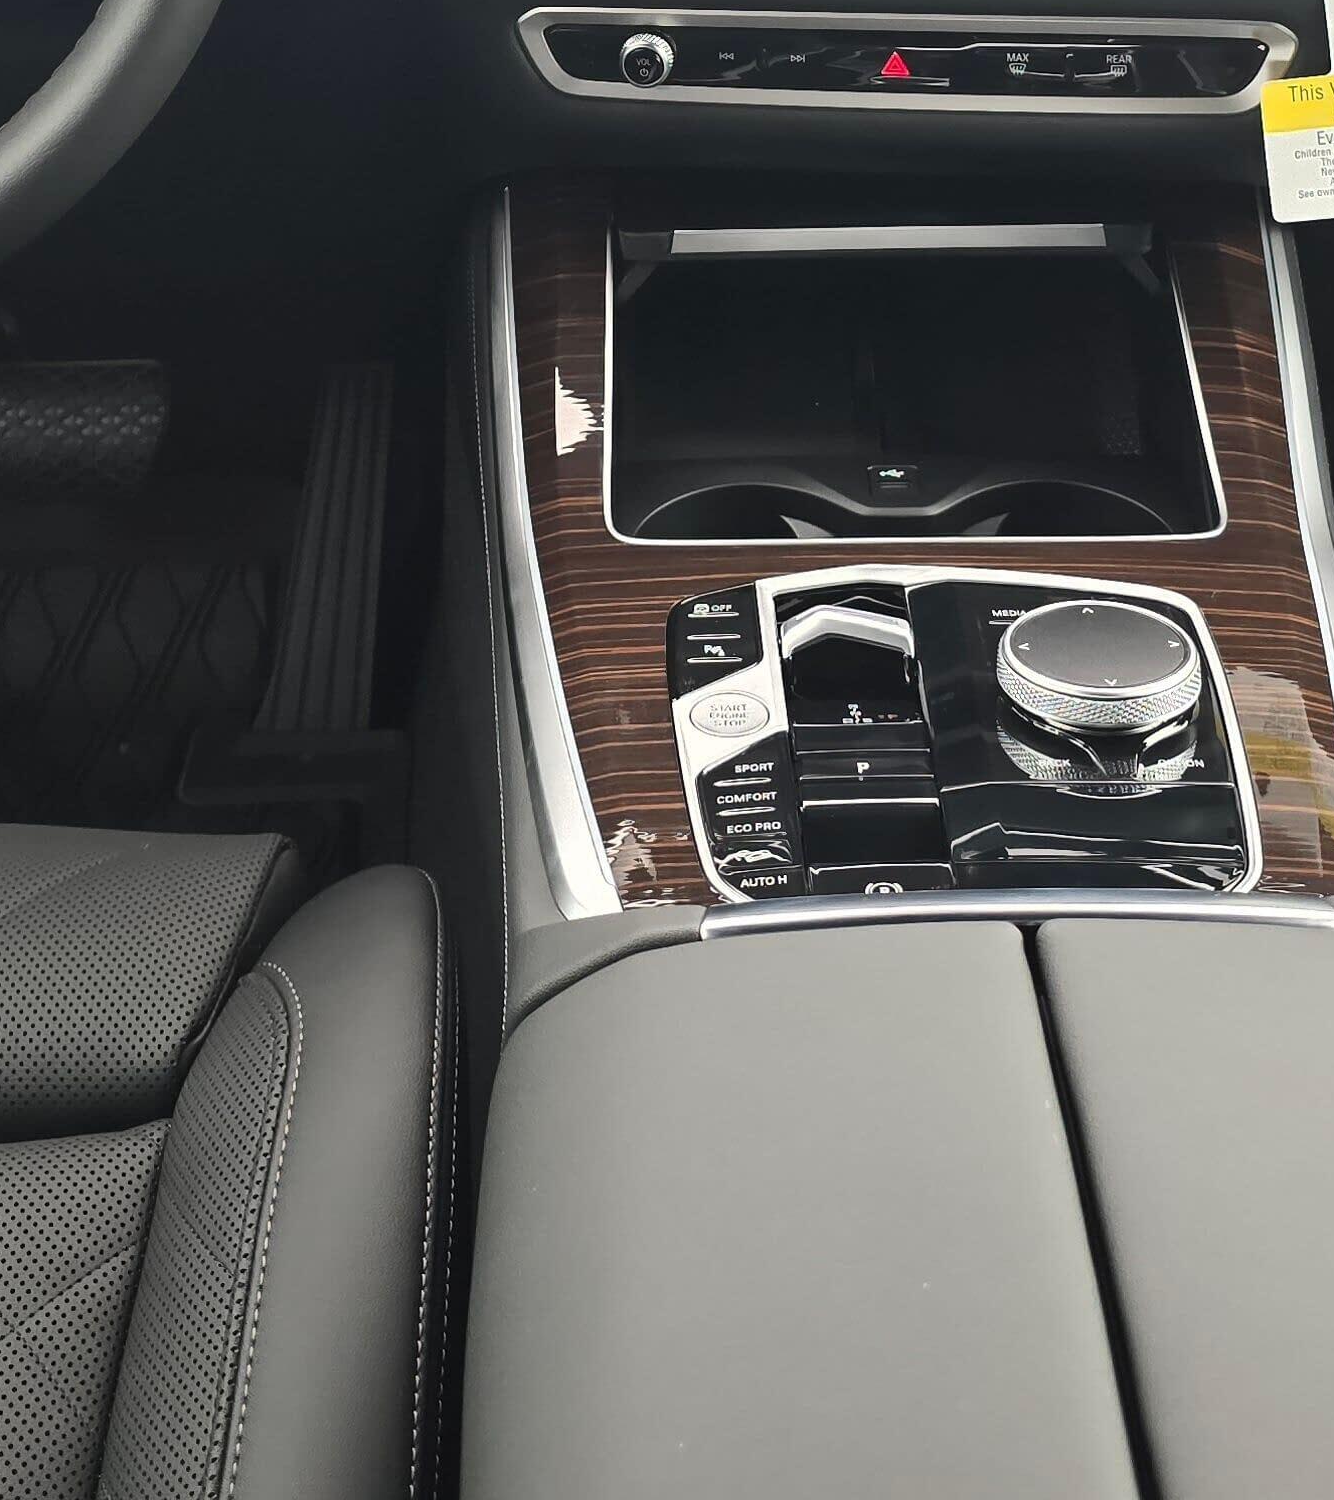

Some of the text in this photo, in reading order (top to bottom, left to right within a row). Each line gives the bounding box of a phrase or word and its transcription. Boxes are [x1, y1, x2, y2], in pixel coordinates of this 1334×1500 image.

[636, 58, 651, 66] VOL
[1006, 53, 1030, 63] MAX
[1106, 54, 1133, 64] REAR
[1288, 85, 1324, 102] This
[1294, 148, 1332, 159] Children
[1298, 189, 1315, 199] See
[711, 604, 733, 612] OFF
[992, 609, 1028, 618] MEDIA
[709, 704, 747, 712] START
[709, 712, 749, 720] ENGINE
[713, 719, 747, 727] STOP
[735, 762, 774, 773] SPORT
[856, 762, 870, 774] P
[717, 791, 778, 804] COMFORT
[726, 821, 782, 834] ECO PRO
[740, 874, 788, 888] AUTO H
